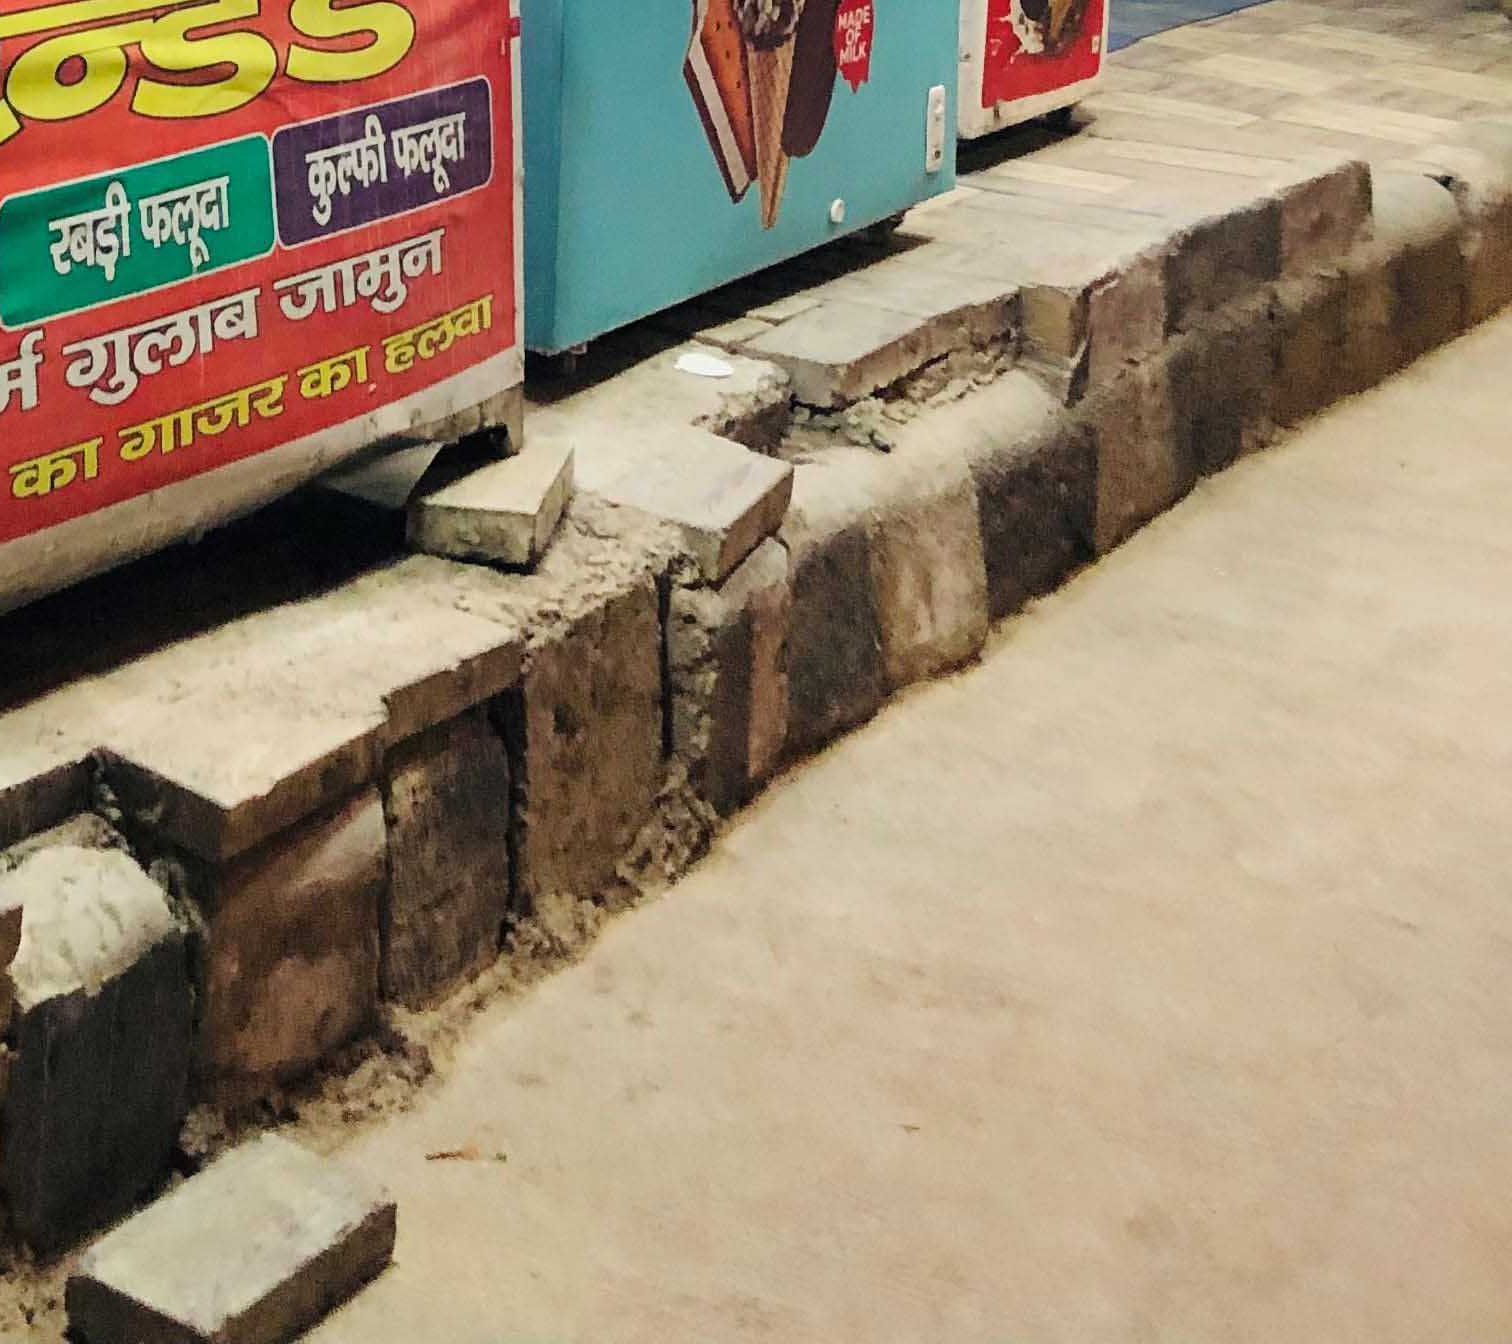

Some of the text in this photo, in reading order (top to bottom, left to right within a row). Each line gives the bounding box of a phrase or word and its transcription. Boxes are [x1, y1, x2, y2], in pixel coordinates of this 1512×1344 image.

[838, 4, 871, 31] MADE
[839, 41, 867, 66] MILK
[305, 112, 466, 226] कुल्फी फलूदा
[139, 175, 230, 269] फलूदा
[62, 287, 260, 404] गुलाब
[274, 228, 446, 313] जामुन
[10, 438, 104, 500] का
[118, 374, 289, 462] गाजर
[298, 344, 371, 400] का
[383, 294, 494, 374] हलवा
